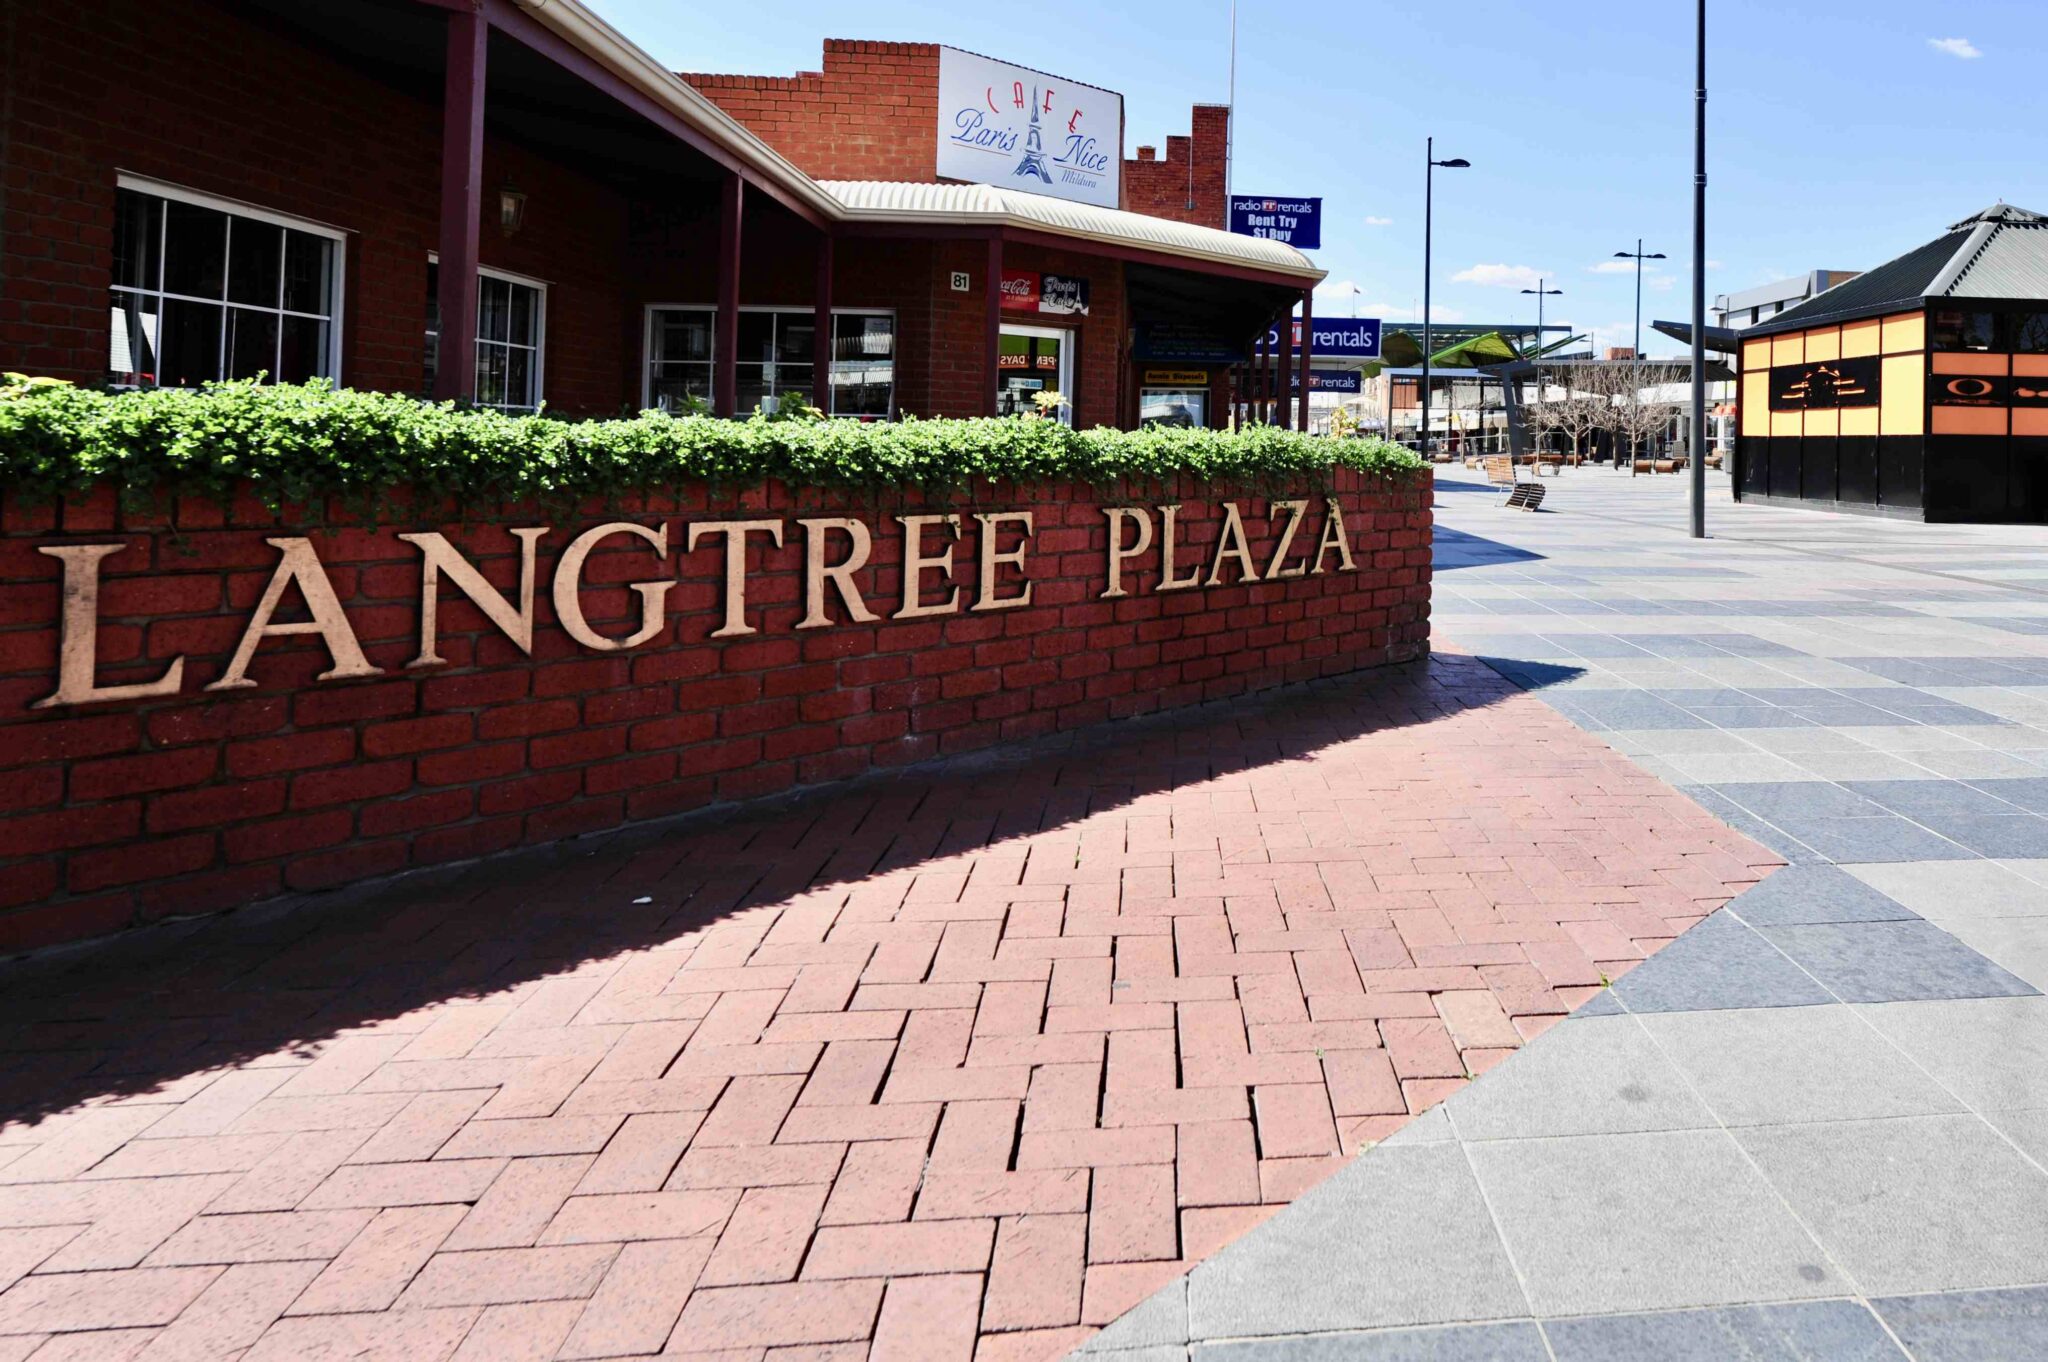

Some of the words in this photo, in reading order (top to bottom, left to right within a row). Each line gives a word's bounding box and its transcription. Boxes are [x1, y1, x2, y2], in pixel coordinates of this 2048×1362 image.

[951, 108, 1018, 151] Paris
[1053, 134, 1108, 171] Nice
[1061, 169, 1097, 188] Mildura
[1234, 199, 1260, 211] radio
[1277, 202, 1312, 213] rentals
[1248, 213, 1275, 226] Rent
[1278, 214, 1298, 229] Try
[1269, 228, 1292, 242] Buy
[953, 274, 967, 290] 81
[1313, 326, 1372, 348] rentals
[1321, 376, 1355, 388] rentals
[29, 511, 1032, 709] LANGTREE
[1100, 498, 1357, 598] PLAZA
